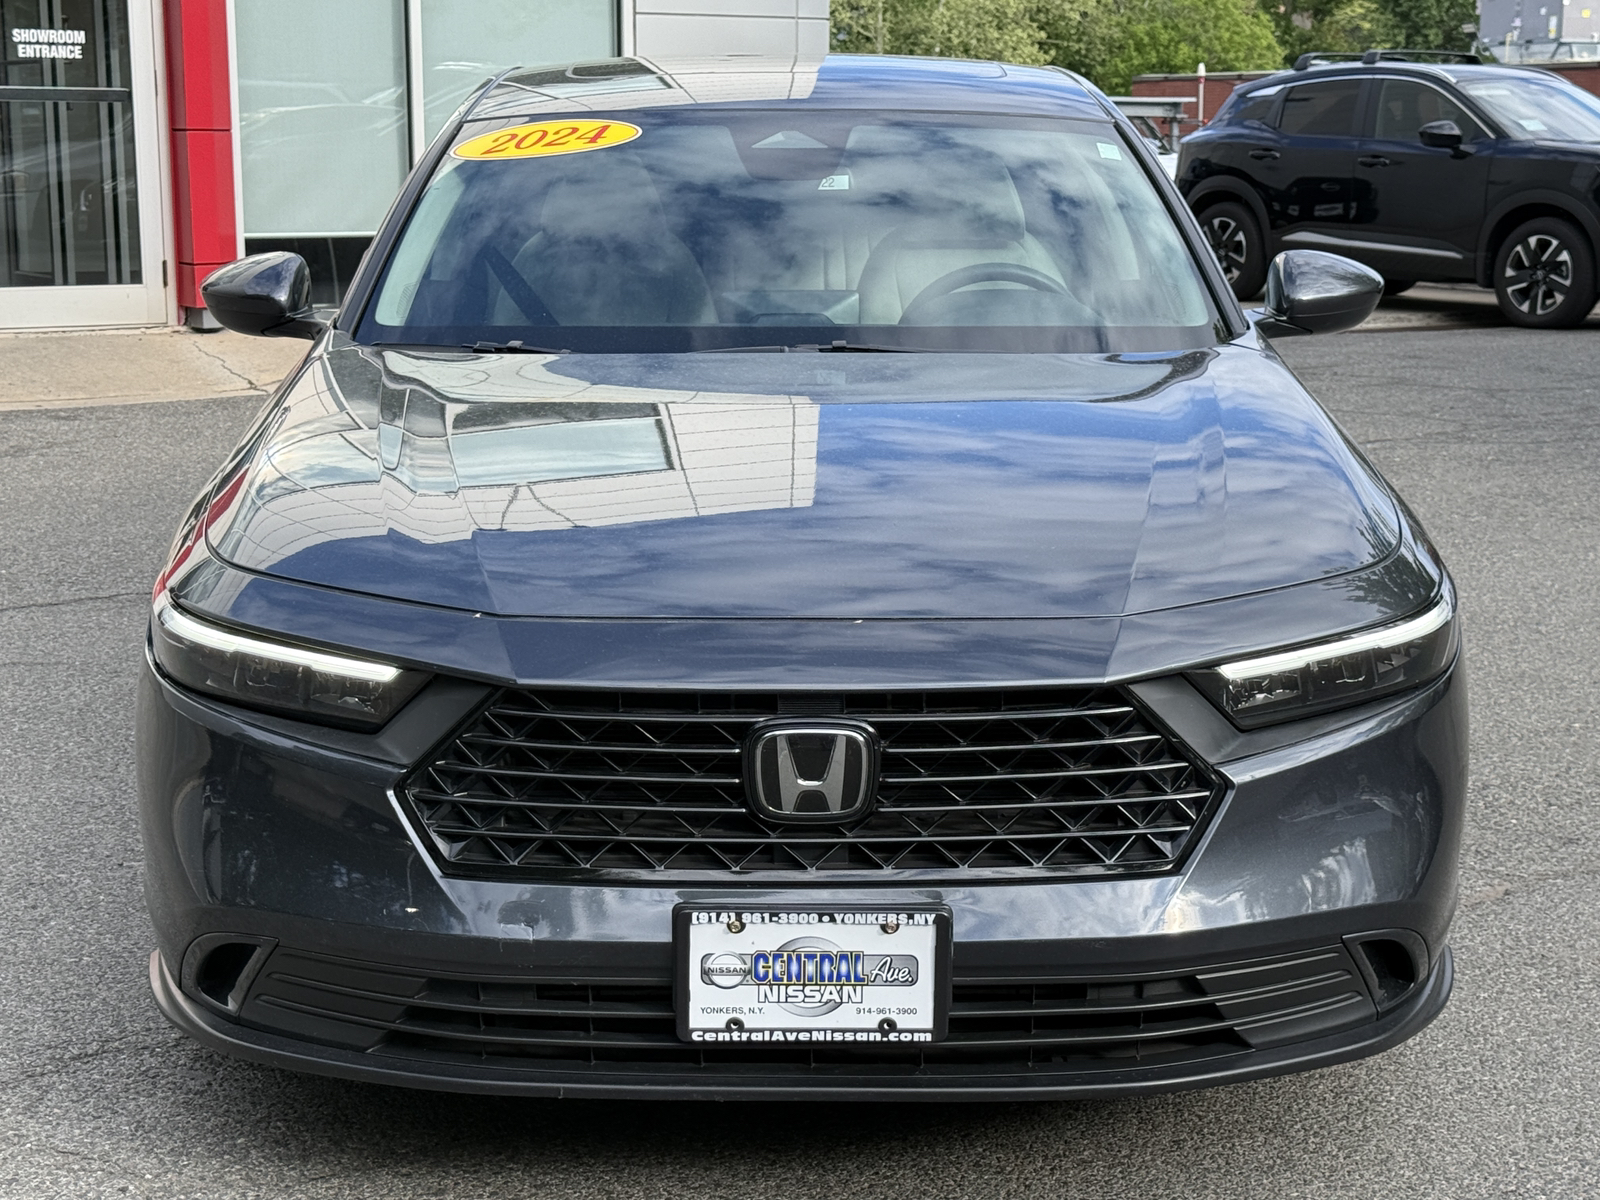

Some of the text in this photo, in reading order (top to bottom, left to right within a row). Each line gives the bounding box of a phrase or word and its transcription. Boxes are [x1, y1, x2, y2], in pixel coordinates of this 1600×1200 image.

[11, 28, 86, 44] SHOWROOM
[17, 44, 83, 59] ENTRANCE
[480, 125, 611, 156] 2024
[706, 966, 747, 974] NISSAN
[751, 950, 915, 985] CENTRAL Ave.
[757, 985, 864, 1004] NISSAN
[700, 1006, 766, 1016] YONKERS, N.Y.
[855, 1007, 918, 1016] 914-961-3900
